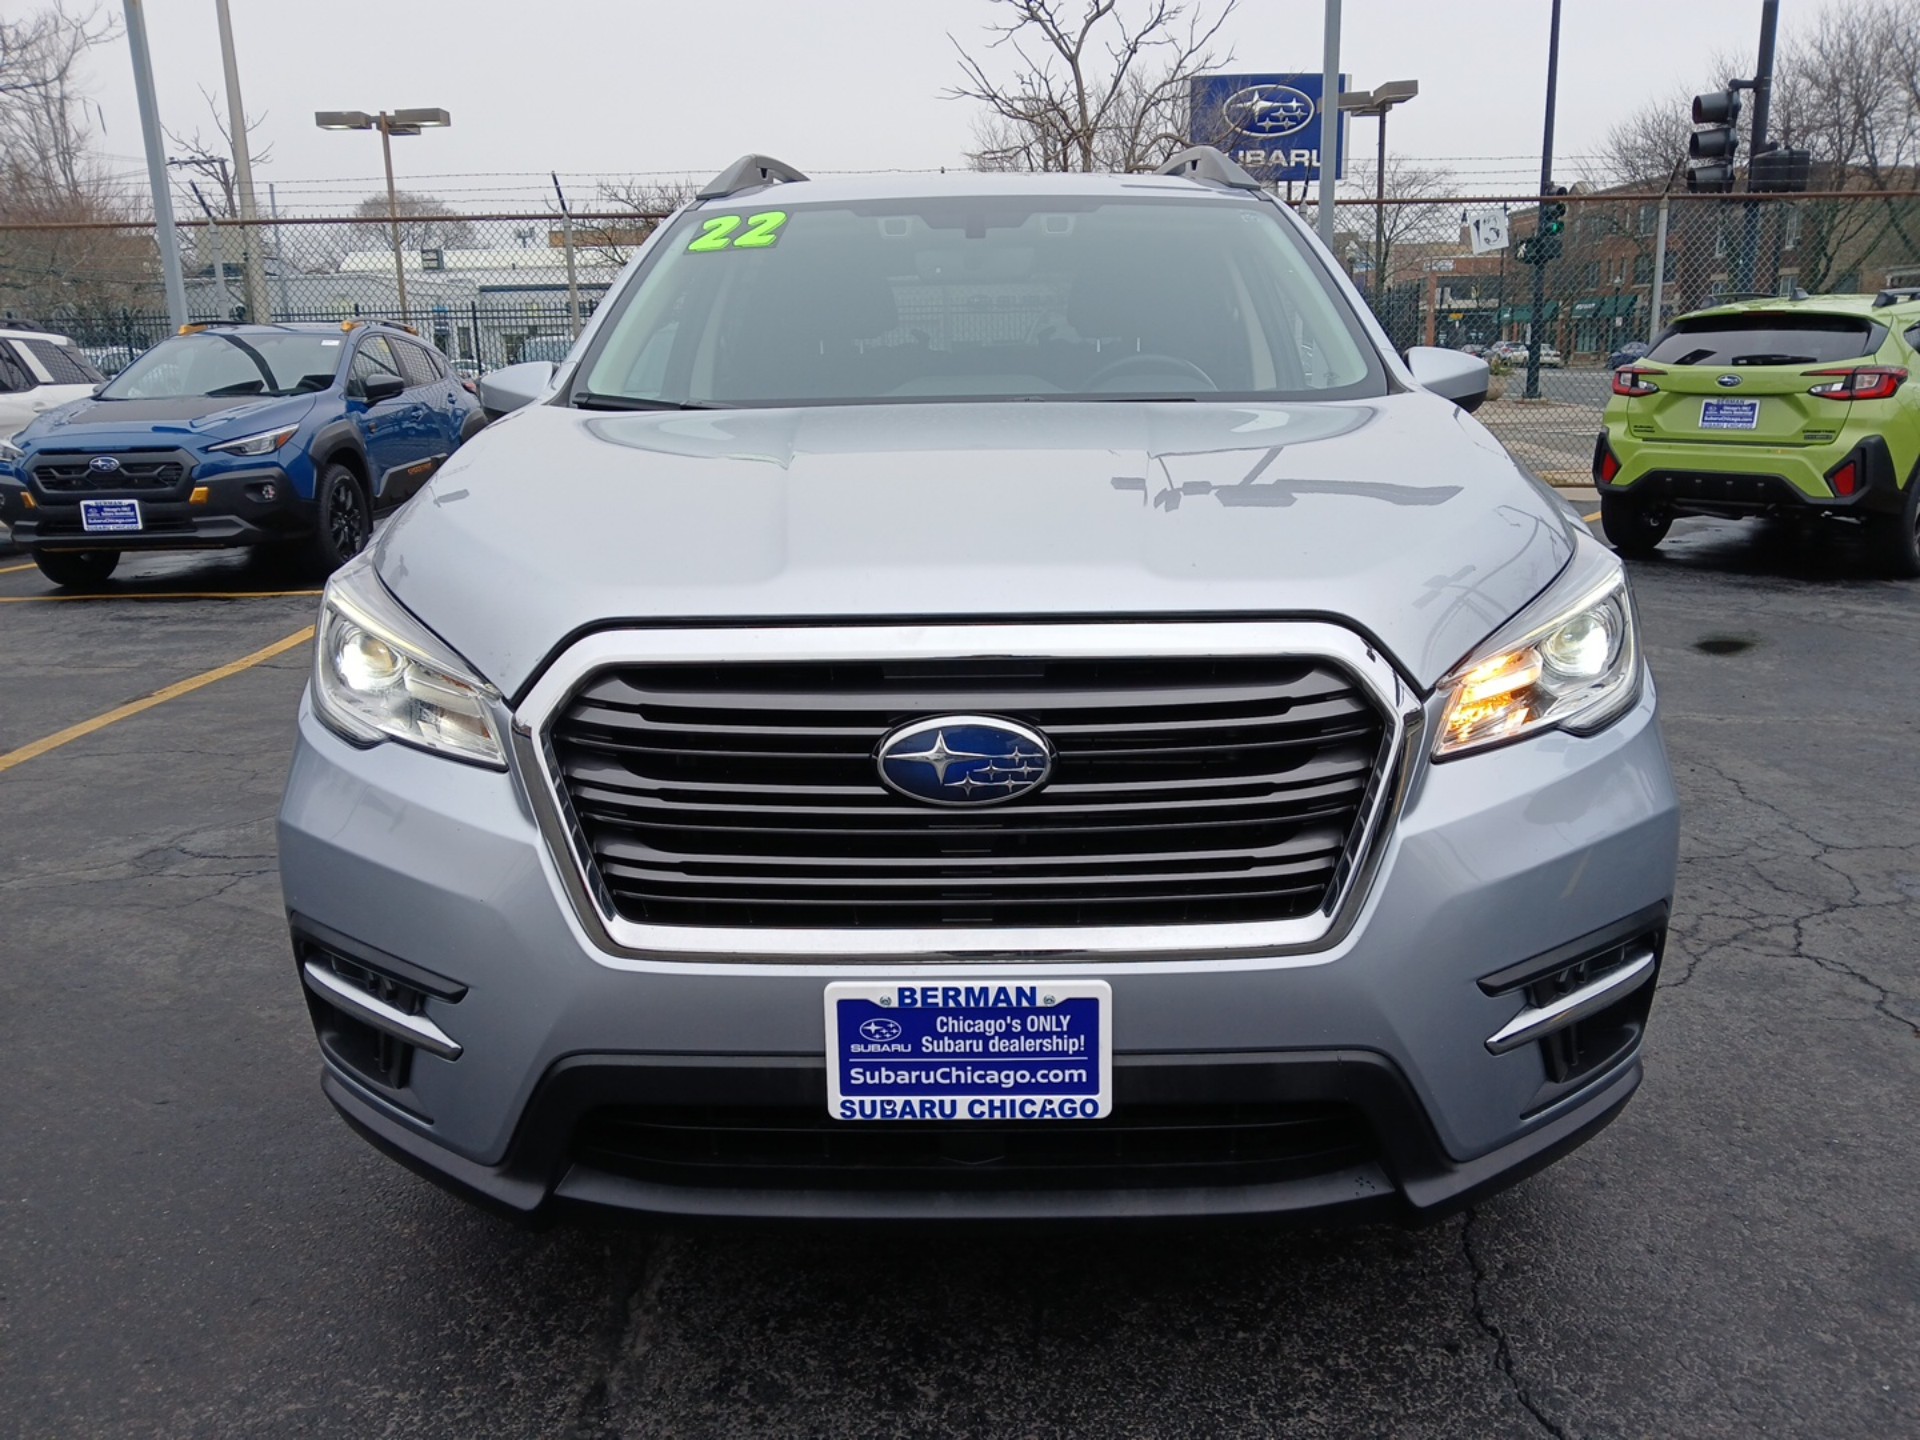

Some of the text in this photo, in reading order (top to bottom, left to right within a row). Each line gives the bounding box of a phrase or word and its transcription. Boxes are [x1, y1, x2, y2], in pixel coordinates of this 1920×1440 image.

[1223, 149, 1321, 167] BAR
[688, 211, 787, 253] 22
[897, 986, 1037, 1008] BERMAN
[936, 1014, 1071, 1036] Chicago's ONLY
[850, 1043, 912, 1053] SUBARU
[921, 1034, 1085, 1055] Subaru dealership!
[849, 1066, 1087, 1088] SubaruChicago.com
[839, 1098, 1100, 1120] SUBARU CHICAGO
